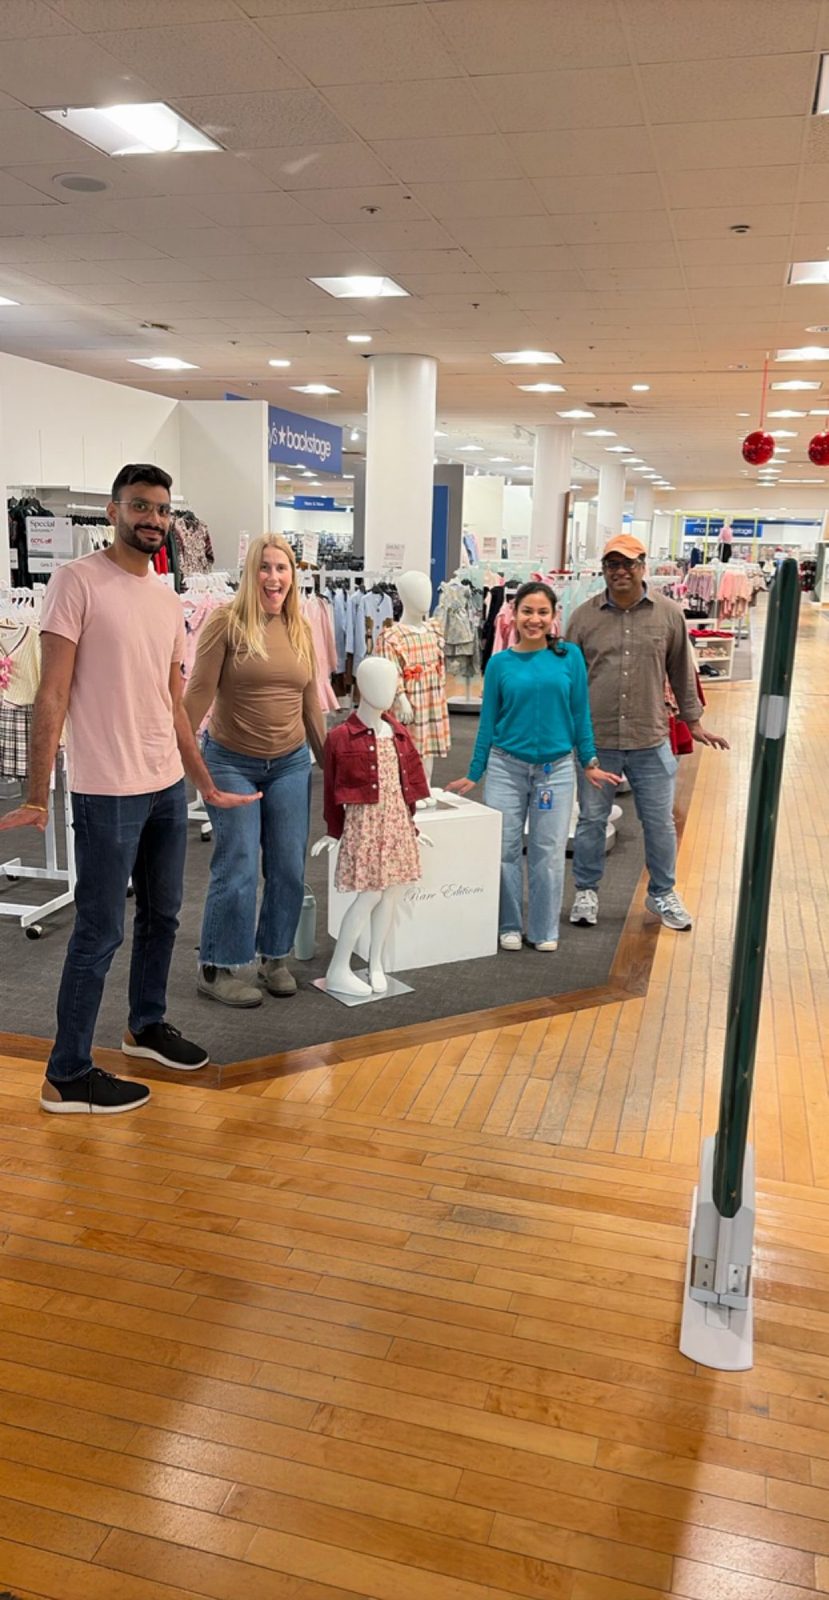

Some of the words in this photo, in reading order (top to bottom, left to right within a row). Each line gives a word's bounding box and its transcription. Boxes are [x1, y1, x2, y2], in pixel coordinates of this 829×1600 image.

[286, 425, 331, 462] backstage
[30, 520, 55, 529] Special
[403, 887, 437, 902] Rare
[440, 883, 485, 899] Editions
